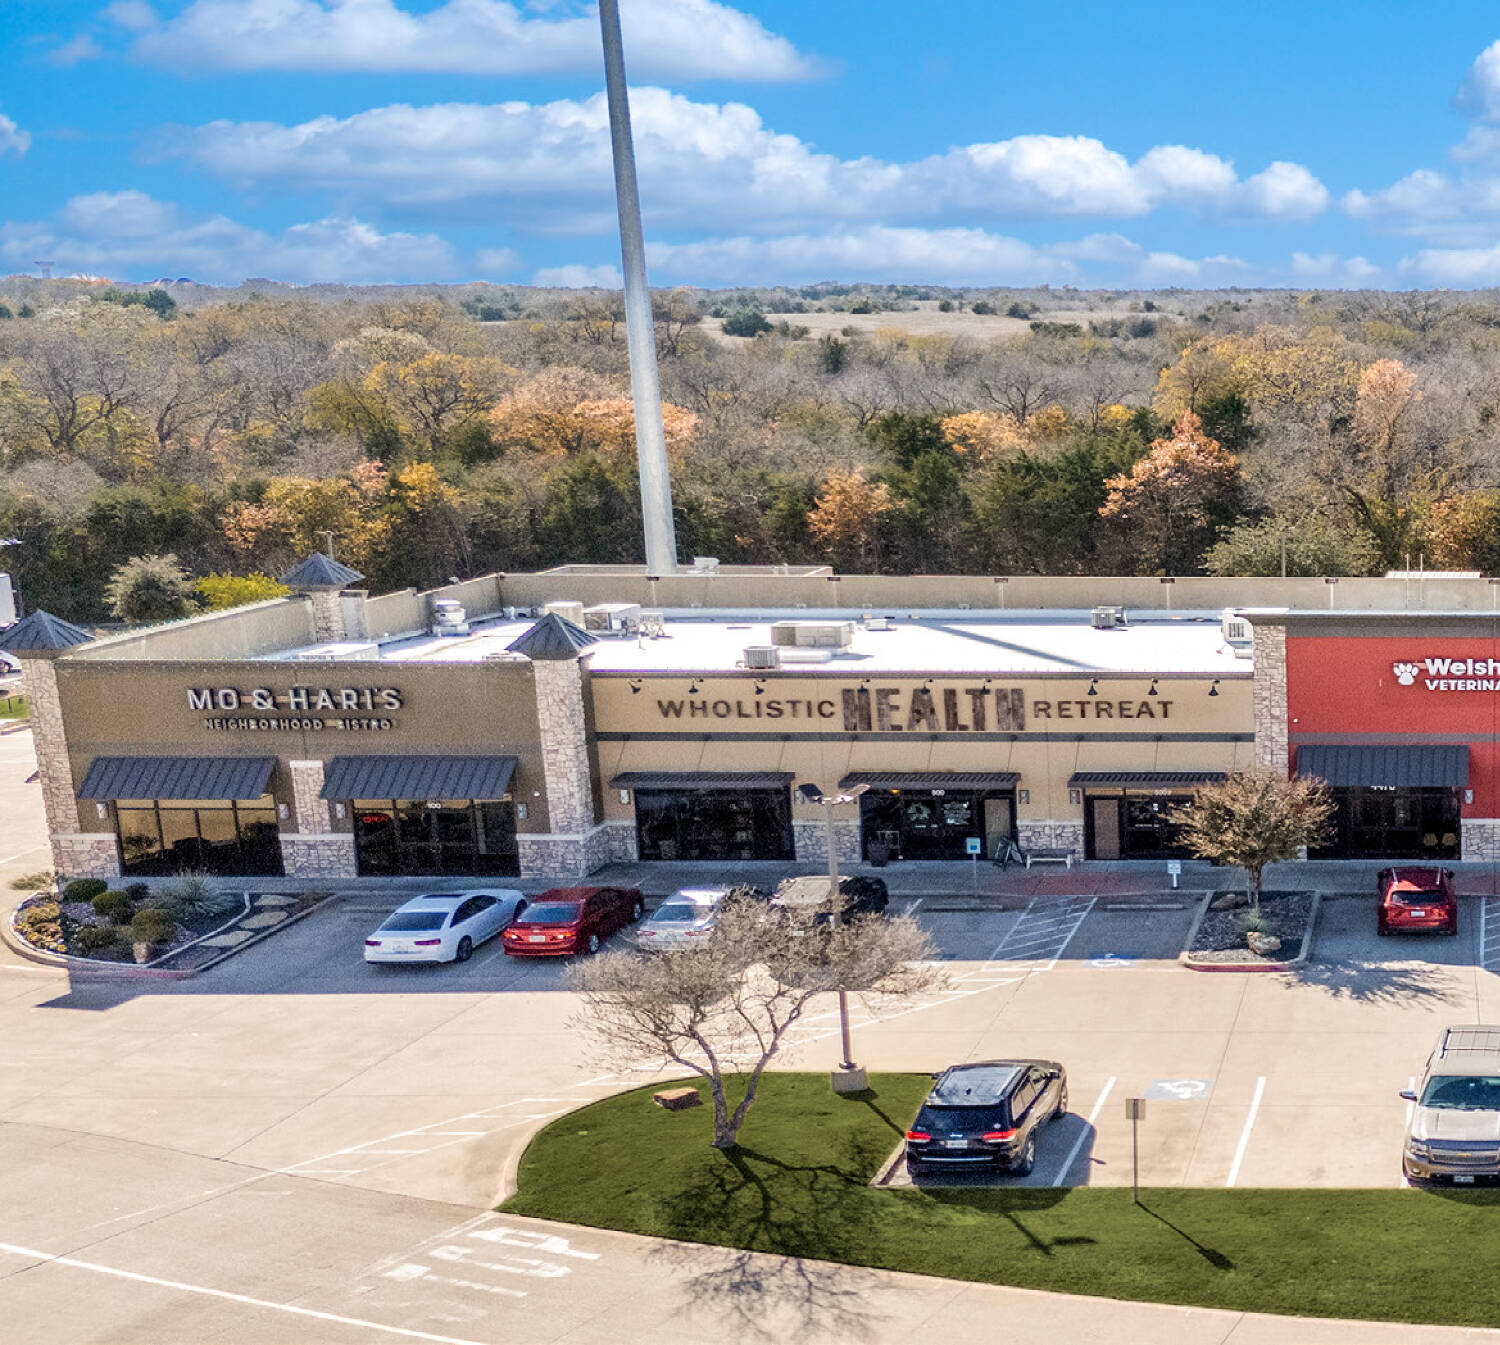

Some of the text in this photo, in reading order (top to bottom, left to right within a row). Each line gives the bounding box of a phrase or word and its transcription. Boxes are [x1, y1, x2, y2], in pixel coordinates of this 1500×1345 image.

[187, 688, 403, 710] MO & HARI'S
[656, 688, 1174, 731] WHOLISTIC HEALTH RETREAT
[205, 718, 393, 731] NEIGHBORHOOD BISTRO
